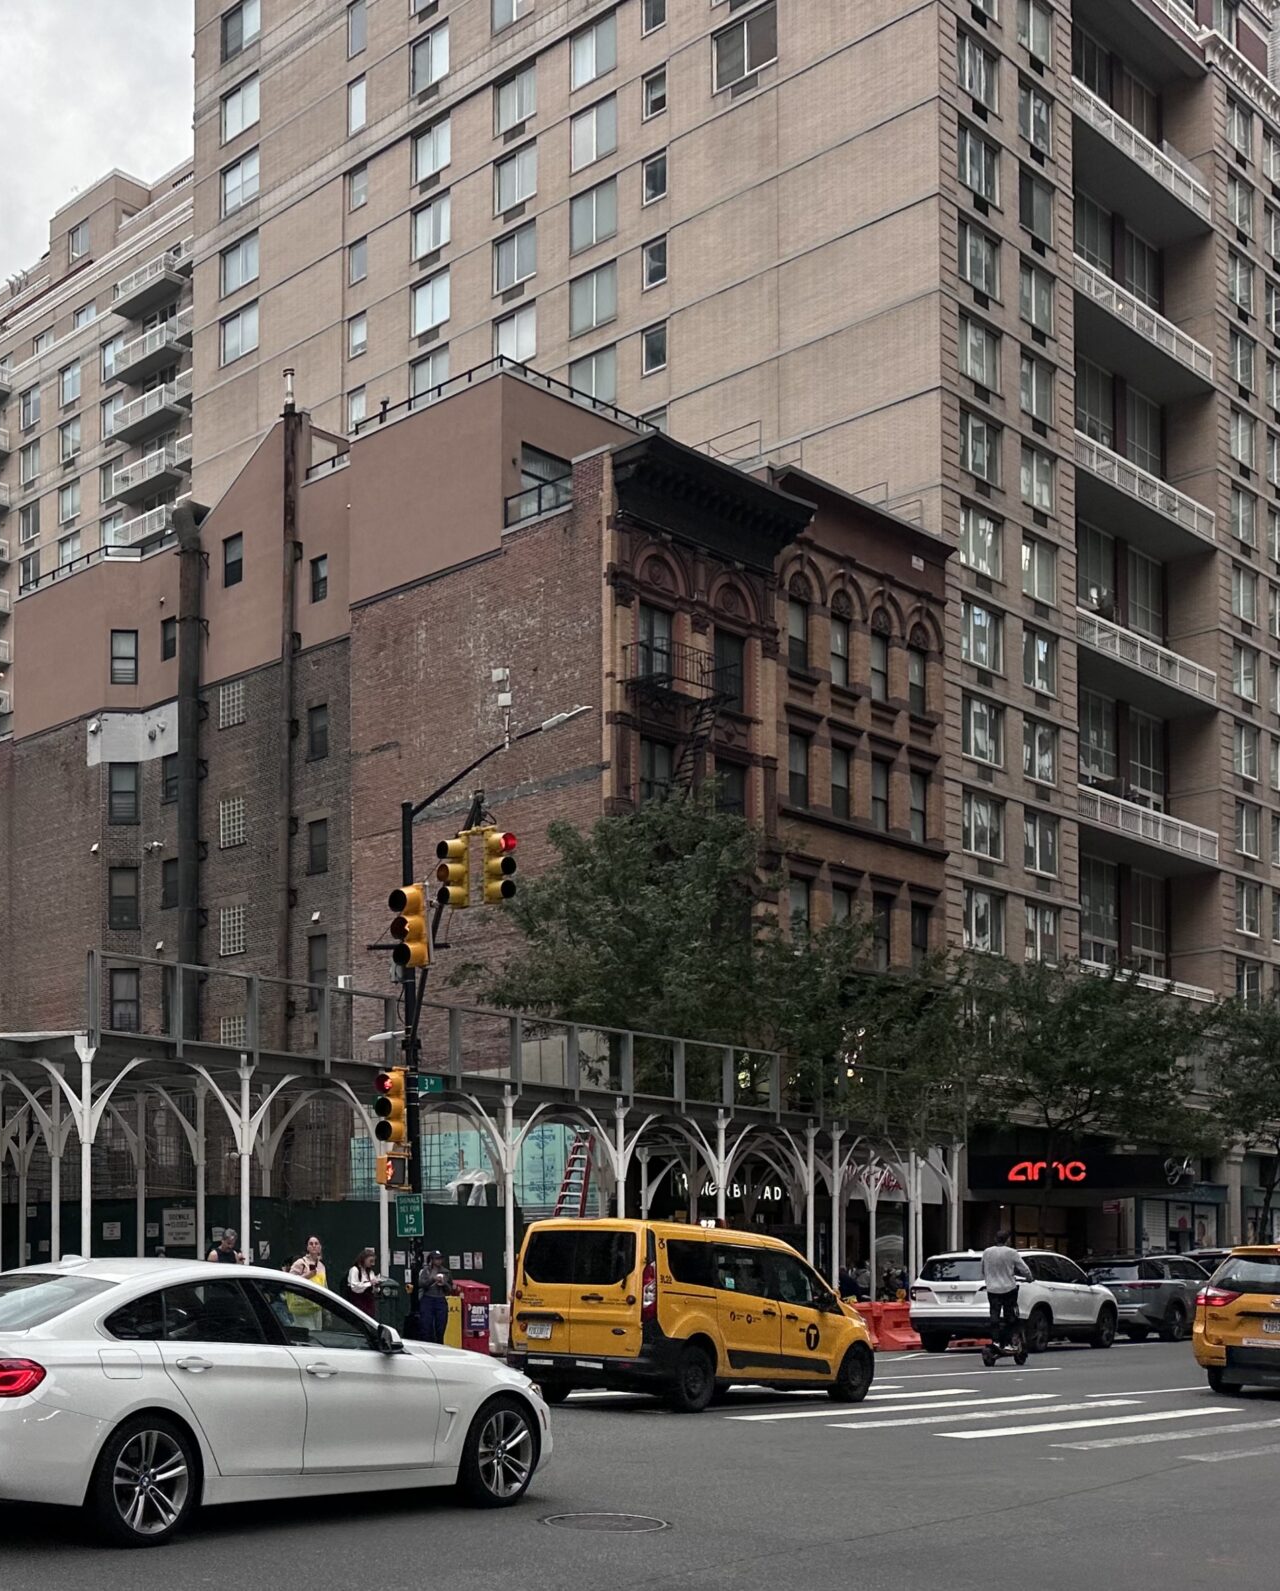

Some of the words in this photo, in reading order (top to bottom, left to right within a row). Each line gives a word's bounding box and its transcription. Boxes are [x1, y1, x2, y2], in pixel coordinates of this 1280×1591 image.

[424, 1078, 430, 1090] 3
[405, 1214, 415, 1225] 15
[404, 1226, 417, 1234] MPH
